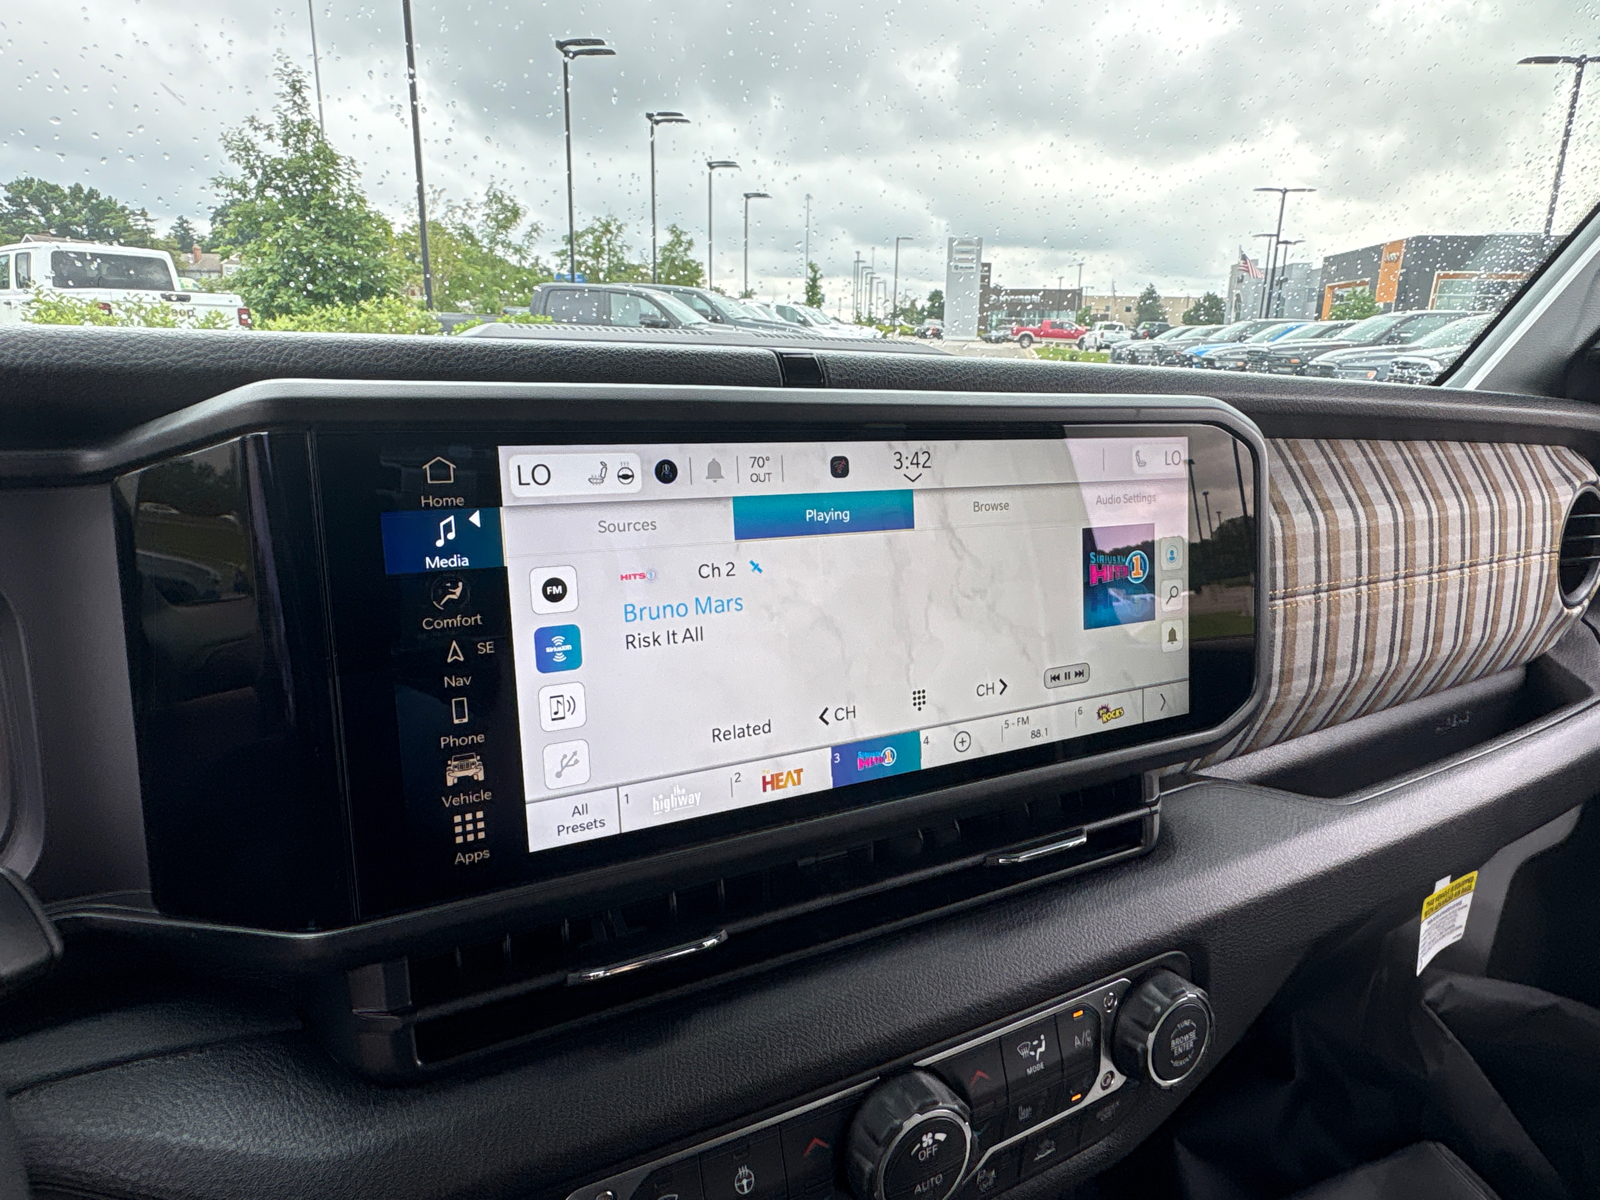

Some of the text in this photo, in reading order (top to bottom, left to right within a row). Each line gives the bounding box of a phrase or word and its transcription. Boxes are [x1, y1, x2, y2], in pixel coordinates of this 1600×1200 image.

[749, 456, 770, 469] 70°
[893, 451, 932, 471] 3:42
[1164, 450, 1182, 466] LO
[518, 463, 552, 487] LO
[749, 472, 772, 483] OUT
[421, 495, 465, 508] Home
[972, 499, 1010, 513] Browse
[1095, 492, 1157, 505] Audio Settings
[805, 507, 851, 524] Playing
[597, 518, 657, 534] Sources
[425, 554, 470, 569] Media
[620, 572, 646, 581] HITS
[698, 561, 736, 579] Ch 2
[1089, 563, 1129, 587] HITS
[546, 585, 563, 595] FM
[623, 595, 744, 623] Bruno Mars
[422, 612, 483, 630] Comfort
[626, 626, 704, 650] Risk It All
[477, 641, 495, 655] SE
[443, 674, 472, 688] Nav
[976, 682, 995, 697] CH
[834, 706, 857, 722] CH
[1077, 706, 1083, 716] 6
[1004, 719, 1010, 729] 5
[1016, 715, 1030, 727] FM
[711, 719, 772, 743] Related
[1030, 727, 1048, 740] 88.1
[440, 731, 486, 749] Phone
[923, 736, 930, 746] 4
[833, 752, 841, 764] 3
[734, 772, 742, 784] 2
[761, 767, 804, 793] HEAT
[673, 784, 686, 796] the
[441, 789, 492, 809] Vehicle
[623, 793, 630, 805] 1
[652, 792, 701, 814] highway
[571, 803, 589, 817] All
[556, 816, 606, 837] Presets
[454, 848, 491, 866] Apps
[1074, 1028, 1093, 1049] A/C
[1170, 1029, 1197, 1049] BROWSE
[1173, 1041, 1194, 1057] ENTER
[1026, 1061, 1045, 1076] MODE
[918, 1143, 939, 1161] OFF
[914, 1173, 943, 1195] AUTO
